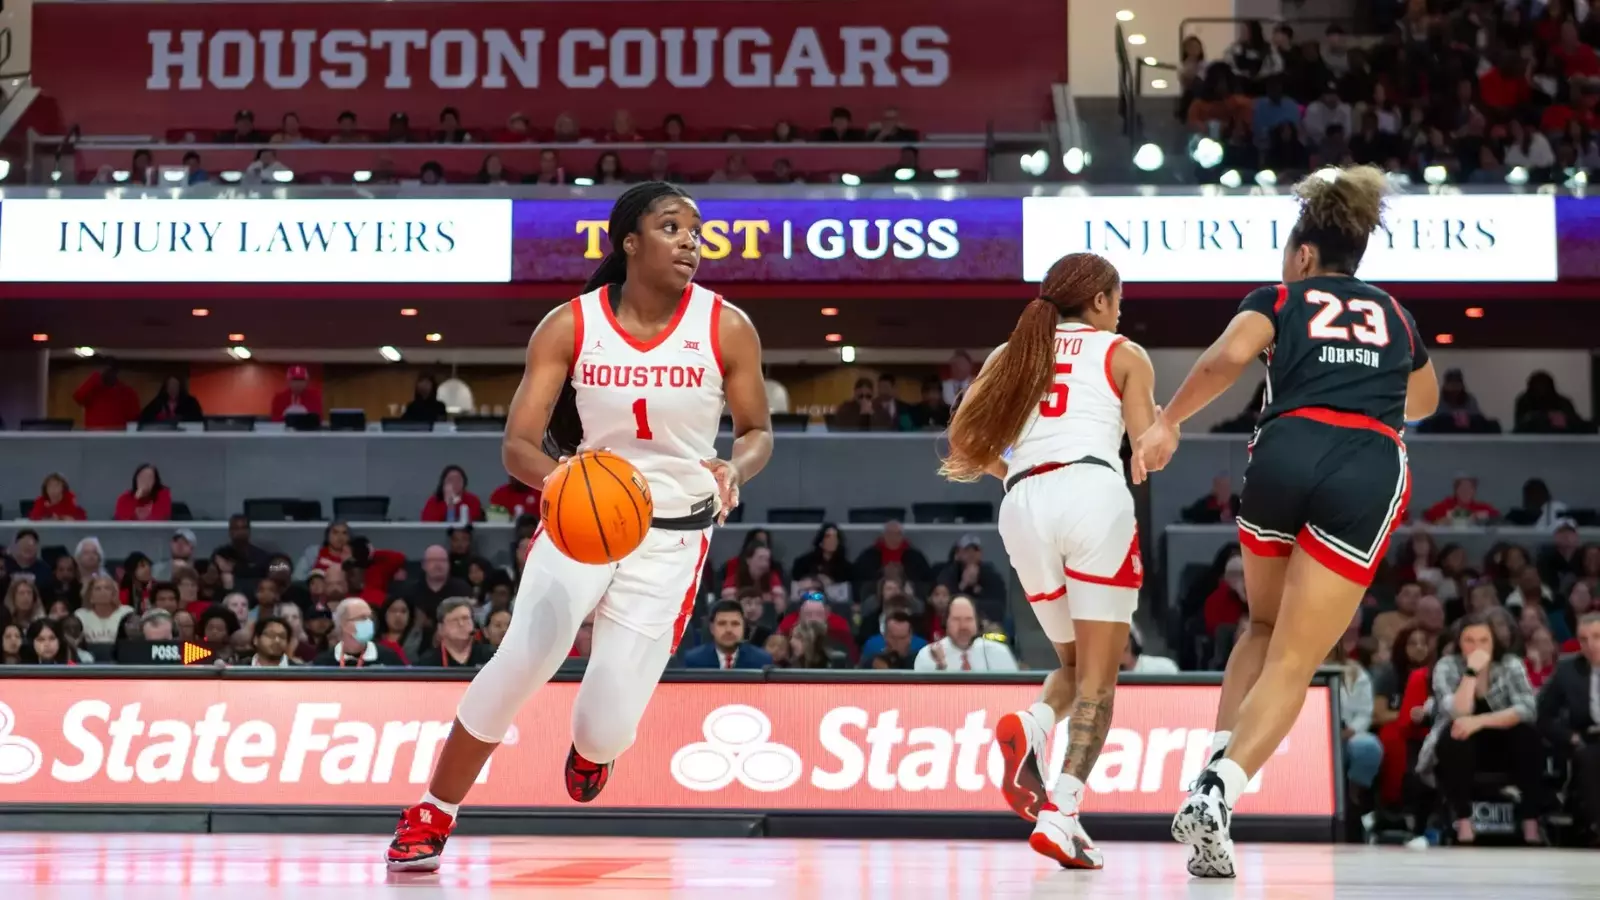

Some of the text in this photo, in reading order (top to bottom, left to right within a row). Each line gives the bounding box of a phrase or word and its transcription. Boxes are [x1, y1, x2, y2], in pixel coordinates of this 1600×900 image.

[146, 27, 950, 90] HOUSTON COUGARS
[58, 221, 456, 259] INJURY LAWYERS
[575, 218, 960, 260] TST GUSS
[1084, 219, 1496, 255] INJURY LYERS
[1304, 288, 1391, 348] 23
[1053, 337, 1083, 356] OYD
[1318, 345, 1380, 369] JOHNSON
[582, 363, 706, 388] HOUSTON
[632, 398, 653, 440] 1
[151, 644, 181, 661] POSS.
